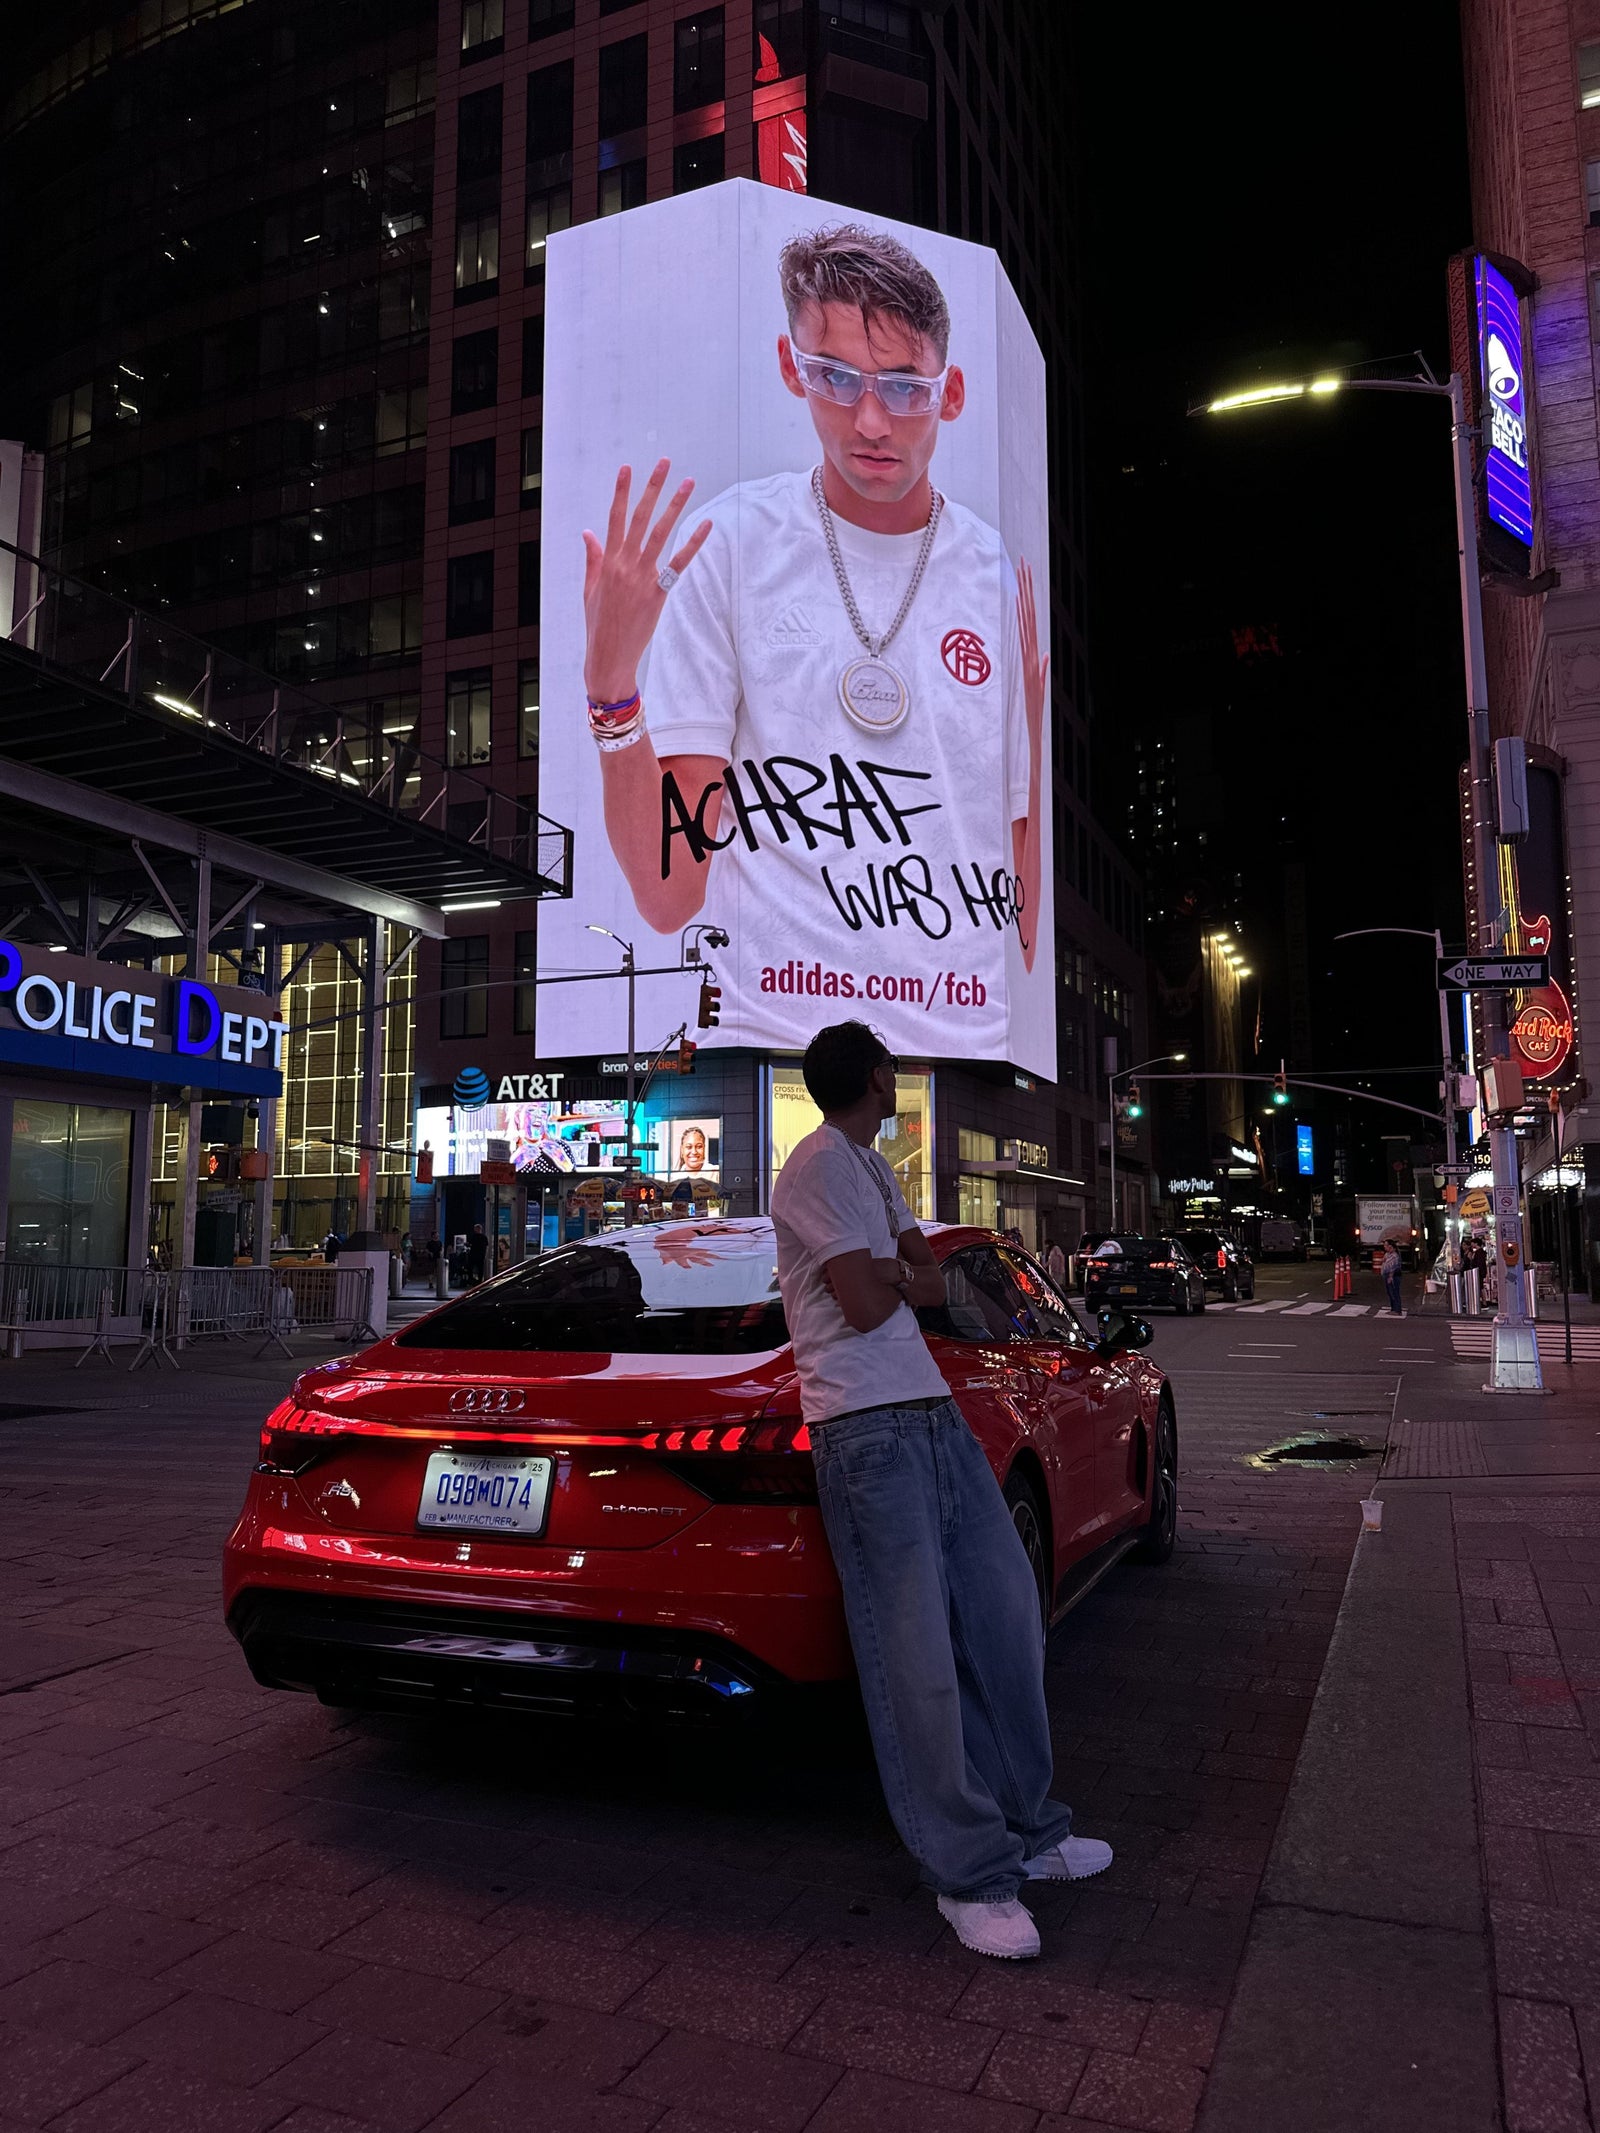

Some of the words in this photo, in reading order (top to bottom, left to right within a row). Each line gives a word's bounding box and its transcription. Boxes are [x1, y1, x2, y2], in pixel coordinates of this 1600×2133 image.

[1489, 399, 1523, 444] TACO
[1491, 423, 1525, 468] BELL
[660, 752, 942, 881] ACHRAF
[821, 854, 951, 939] WAS
[1454, 967, 1485, 979] ONE
[1500, 965, 1534, 978] WAY
[760, 960, 986, 1011] adidas.com/fcb
[177, 980, 290, 1068] DEPT
[1510, 1017, 1537, 1035] ard
[1538, 1017, 1573, 1043] Rock
[1528, 1041, 1549, 1051] CAFE
[602, 1059, 677, 1073] branedcties
[497, 1073, 564, 1100] AT&T
[774, 1093, 805, 1101] campus
[1015, 1139, 1049, 1168] TOURO
[1168, 1179, 1191, 1194] Harry
[1190, 1177, 1214, 1193] Potter
[473, 1458, 517, 1471] MICHIGAN
[436, 1473, 533, 1510] 098M074
[425, 1513, 438, 1521] FEB
[446, 1513, 512, 1526] MANUFACTURER
[602, 1504, 659, 1514] e-tron
[661, 1507, 687, 1516] GT
